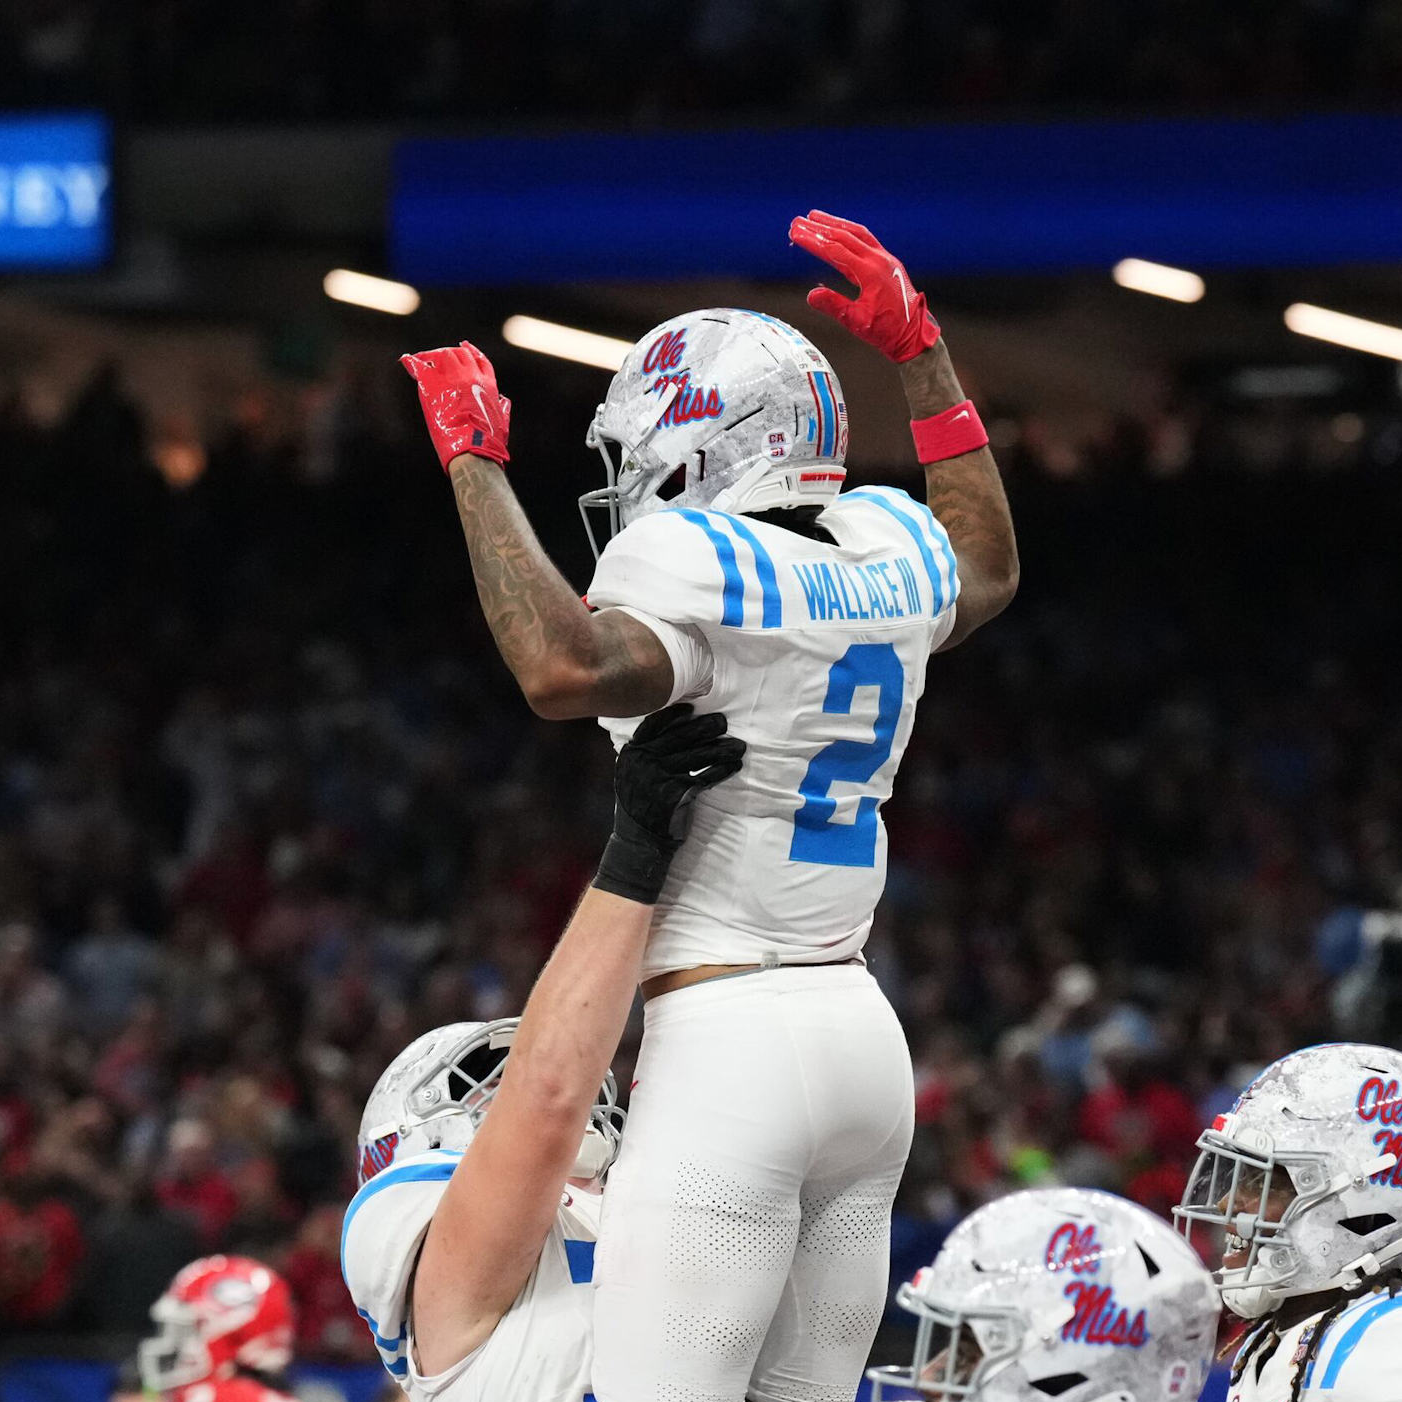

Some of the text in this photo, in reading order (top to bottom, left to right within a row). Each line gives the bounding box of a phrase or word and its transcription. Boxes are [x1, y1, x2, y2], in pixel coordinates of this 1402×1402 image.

[642, 327, 688, 376] Ole
[653, 371, 725, 430] Miss
[791, 557, 922, 620] WALLACE III
[789, 642, 905, 868] 2
[1046, 1221, 1103, 1275] Ole
[1061, 1281, 1151, 1347] Miss
